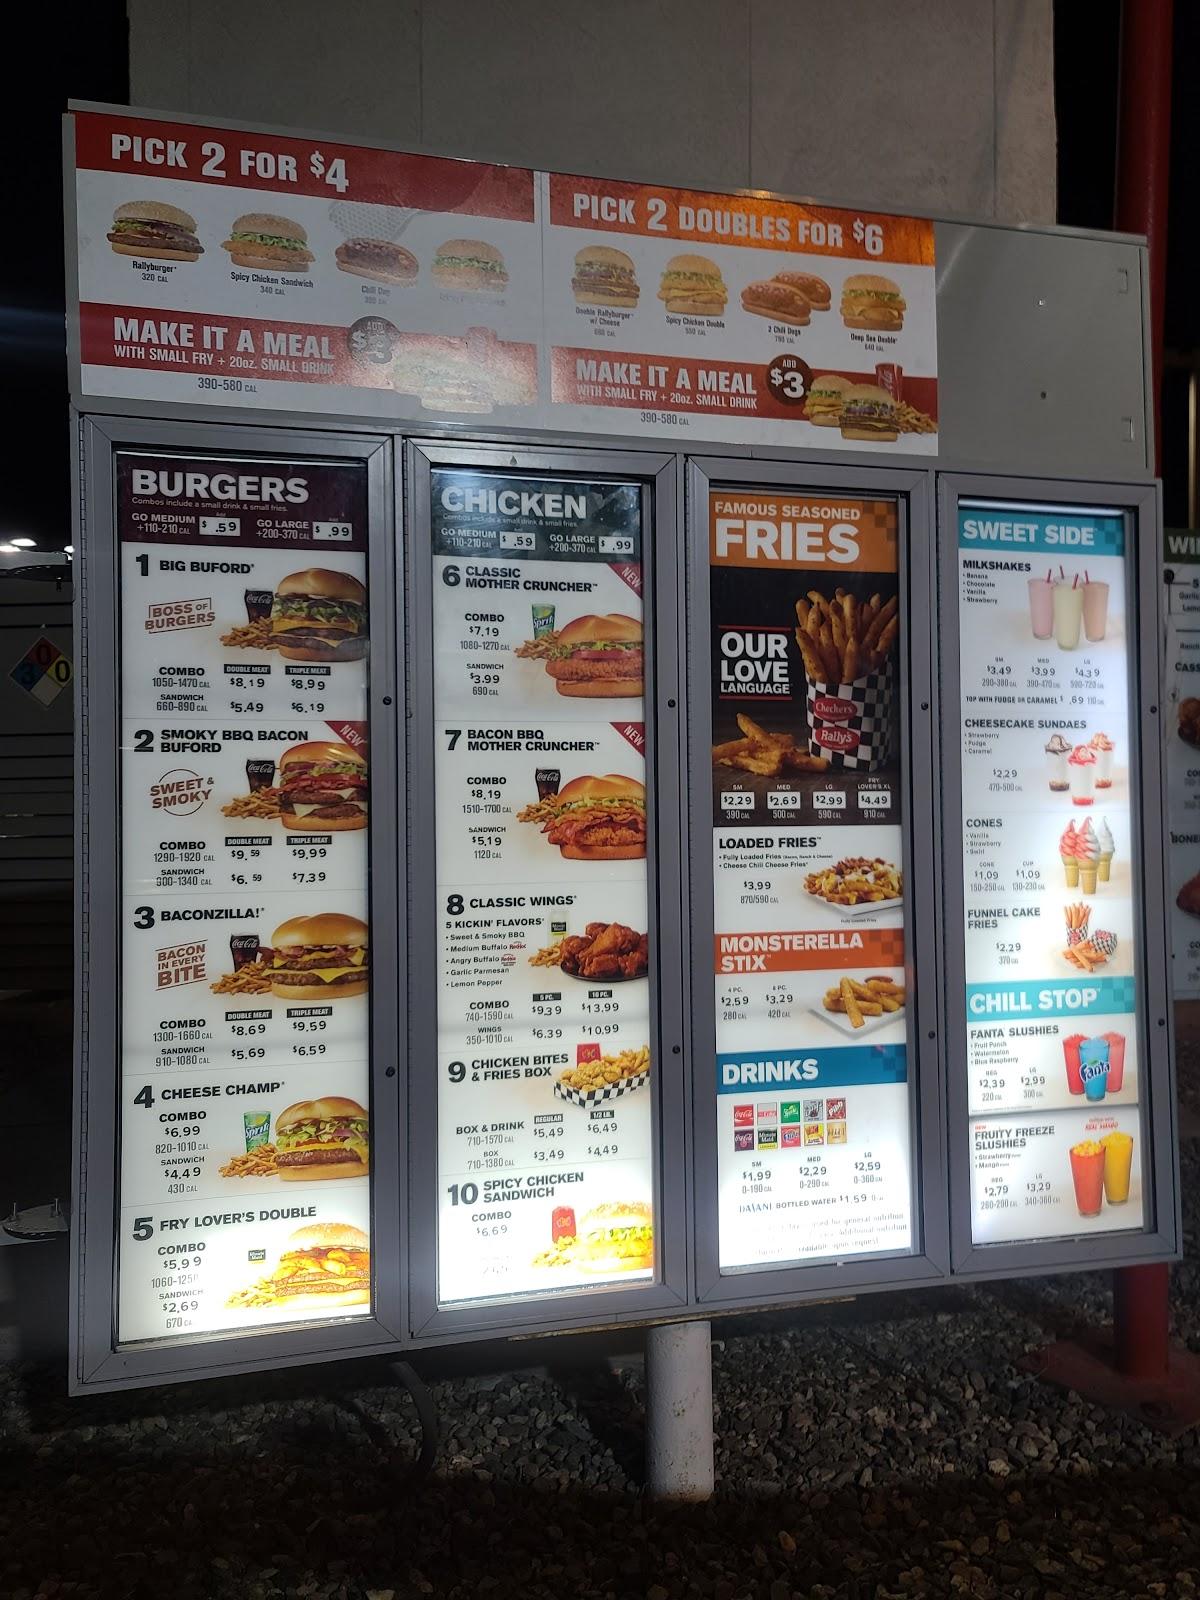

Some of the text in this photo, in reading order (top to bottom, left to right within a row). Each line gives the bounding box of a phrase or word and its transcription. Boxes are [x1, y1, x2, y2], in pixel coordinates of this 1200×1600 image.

[111, 133, 349, 193] PICK 2 FOR $4
[574, 193, 884, 256] PICK 2 DOUBLES FOR $6
[231, 272, 314, 288] Spicy Chicken Sandwich
[114, 317, 194, 346] MAKE
[203, 326, 227, 349] IT
[237, 328, 255, 352] A
[264, 331, 334, 360] MEAL
[114, 345, 336, 376] WITH SMALL FRY 20oz. SMALL DRINK
[782, 359, 797, 368] ADD
[576, 358, 757, 395] MAKE IT A MEAL
[198, 377, 257, 393] 390-580 CAL
[770, 369, 804, 399] $3
[577, 384, 758, 410] WITH SMALL FRY 20oz. SMALL DRINK
[132, 469, 309, 503] BURGERS
[442, 485, 586, 519] CHICKEN
[715, 501, 861, 520] FAMOUS SEASONED
[132, 513, 196, 523] GO MEDIUM
[137, 523, 178, 533] +110-210
[963, 520, 1038, 543] SWEET
[715, 518, 860, 564] FRIES
[1167, 535, 1200, 556] WI
[160, 561, 186, 571] BIG
[466, 566, 520, 578] CLASSIC
[963, 560, 1031, 572] MILKSHAKES
[442, 565, 461, 586] 6
[153, 602, 209, 618] BOSS OF
[145, 612, 215, 629] BURGERS
[721, 632, 788, 659] OUR
[54, 658, 71, 684] 0
[159, 667, 204, 676] COMBO
[721, 660, 789, 683] LOVE
[987, 665, 1011, 675] $3.49
[152, 678, 197, 687] 1050-1470
[230, 678, 265, 689] $8.19
[721, 682, 790, 694] LANGUAGE
[230, 702, 264, 712] $5.49
[816, 700, 853, 714] Checkers
[965, 719, 1034, 728] CHEESECAKE
[134, 730, 154, 752] 2
[161, 730, 308, 741] SMOKY BBQ BACON
[445, 729, 462, 751] 7
[468, 730, 544, 740] BACON BBQ
[821, 730, 852, 744] Rally's
[161, 743, 221, 753] BUFORD
[468, 741, 522, 751] MOTHER
[993, 769, 1017, 778] $2.29
[150, 777, 214, 797] SWEET &
[467, 777, 506, 785] COMBO
[152, 789, 212, 809] SMOKY
[472, 789, 501, 800] $8.19
[723, 796, 752, 806] $2.29
[966, 819, 1002, 828] CONES
[719, 838, 774, 849] LOADED
[975, 870, 998, 879] $1.09
[744, 880, 771, 890] $3.99
[446, 894, 465, 915] 8
[470, 898, 526, 908] CLASSIC
[134, 906, 155, 929] 3
[968, 908, 1041, 918] FUNNEL CAKE
[968, 920, 998, 929] FRIES
[482, 932, 506, 940] Smoky
[720, 933, 863, 953] MONSTERELLA
[158, 944, 205, 962] BACON
[451, 944, 479, 952] Medium
[158, 954, 204, 970] IN EVERY
[157, 964, 206, 987] BITE
[451, 979, 502, 988] Lemon Pepper
[721, 996, 749, 1006] $2.59
[970, 992, 1032, 1014] CHILL
[231, 1024, 266, 1036] $8.69
[583, 1024, 619, 1036] $10.99
[971, 1025, 1059, 1039] FANTA SLUSHIES
[472, 1054, 569, 1069] CHICKEN BITES
[448, 1061, 466, 1083] 9
[472, 1068, 552, 1081] & FRIES BOX
[723, 1059, 819, 1085] DRINKS
[1080, 1063, 1111, 1082] Fanta
[980, 1081, 1005, 1089] $2.39
[133, 1086, 155, 1109] 4
[161, 1086, 221, 1100] CHEESE
[165, 1126, 200, 1138] $6.99
[975, 1126, 1055, 1140] FRUITY FREEZE
[975, 1138, 1026, 1150] SLUSHIES
[800, 1167, 827, 1176] $2.29
[484, 1172, 584, 1190] SPICY CHICKEN
[448, 1183, 478, 1206] 10
[484, 1187, 554, 1203] SANDWICH
[776, 1197, 836, 1209] BOTTLED WATER
[160, 1206, 316, 1231] FRY LOVER'S DOUBLE
[132, 1216, 153, 1241] 5
